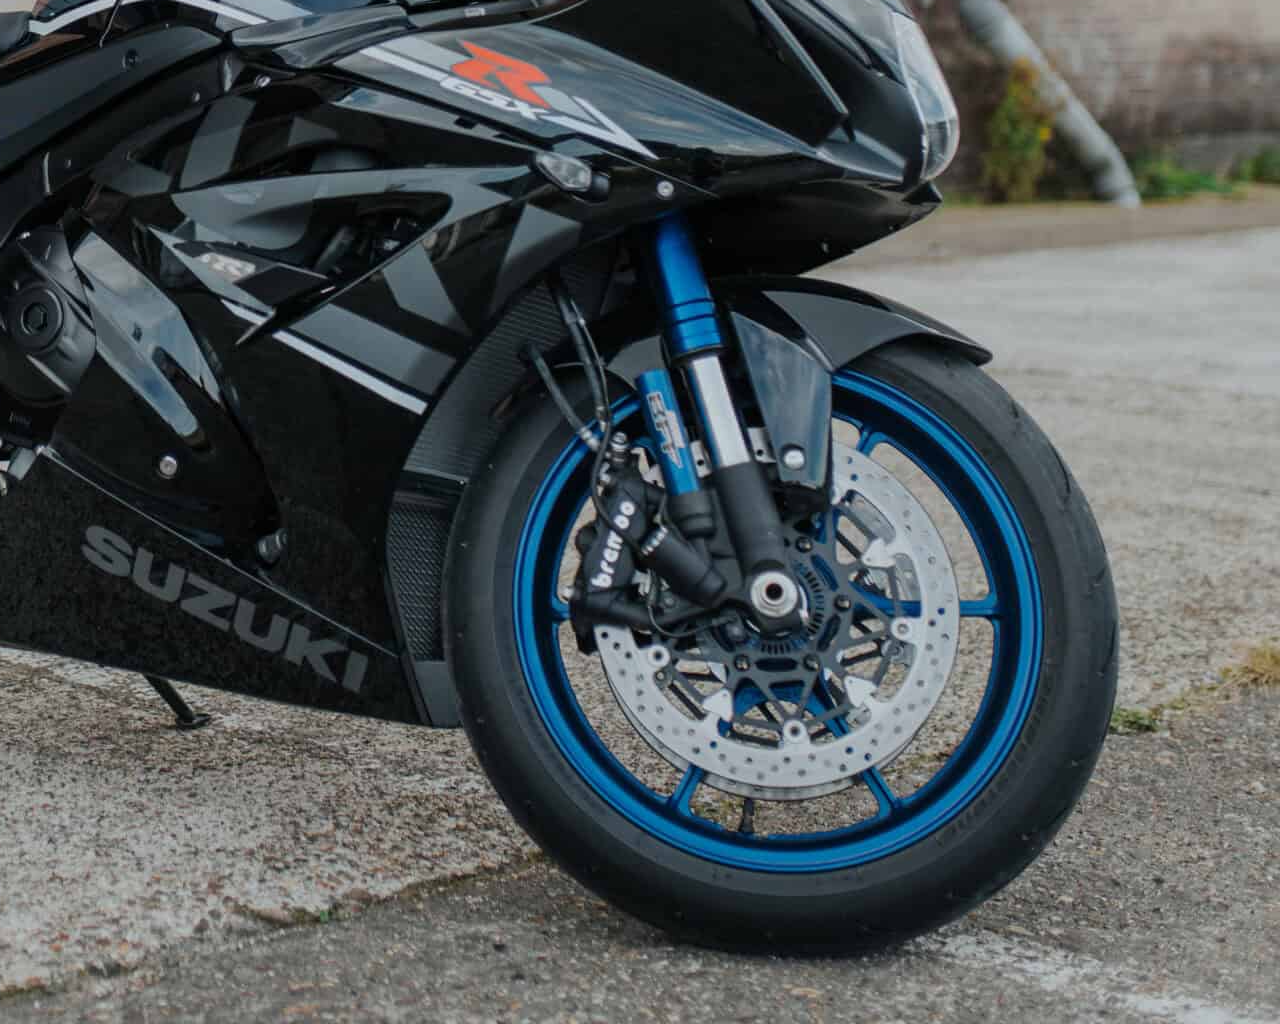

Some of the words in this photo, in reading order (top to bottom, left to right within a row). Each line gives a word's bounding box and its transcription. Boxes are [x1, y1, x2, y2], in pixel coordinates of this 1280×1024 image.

[440, 76, 552, 121] GSX
[450, 40, 552, 110] R
[81, 525, 369, 695] SUZUKI
